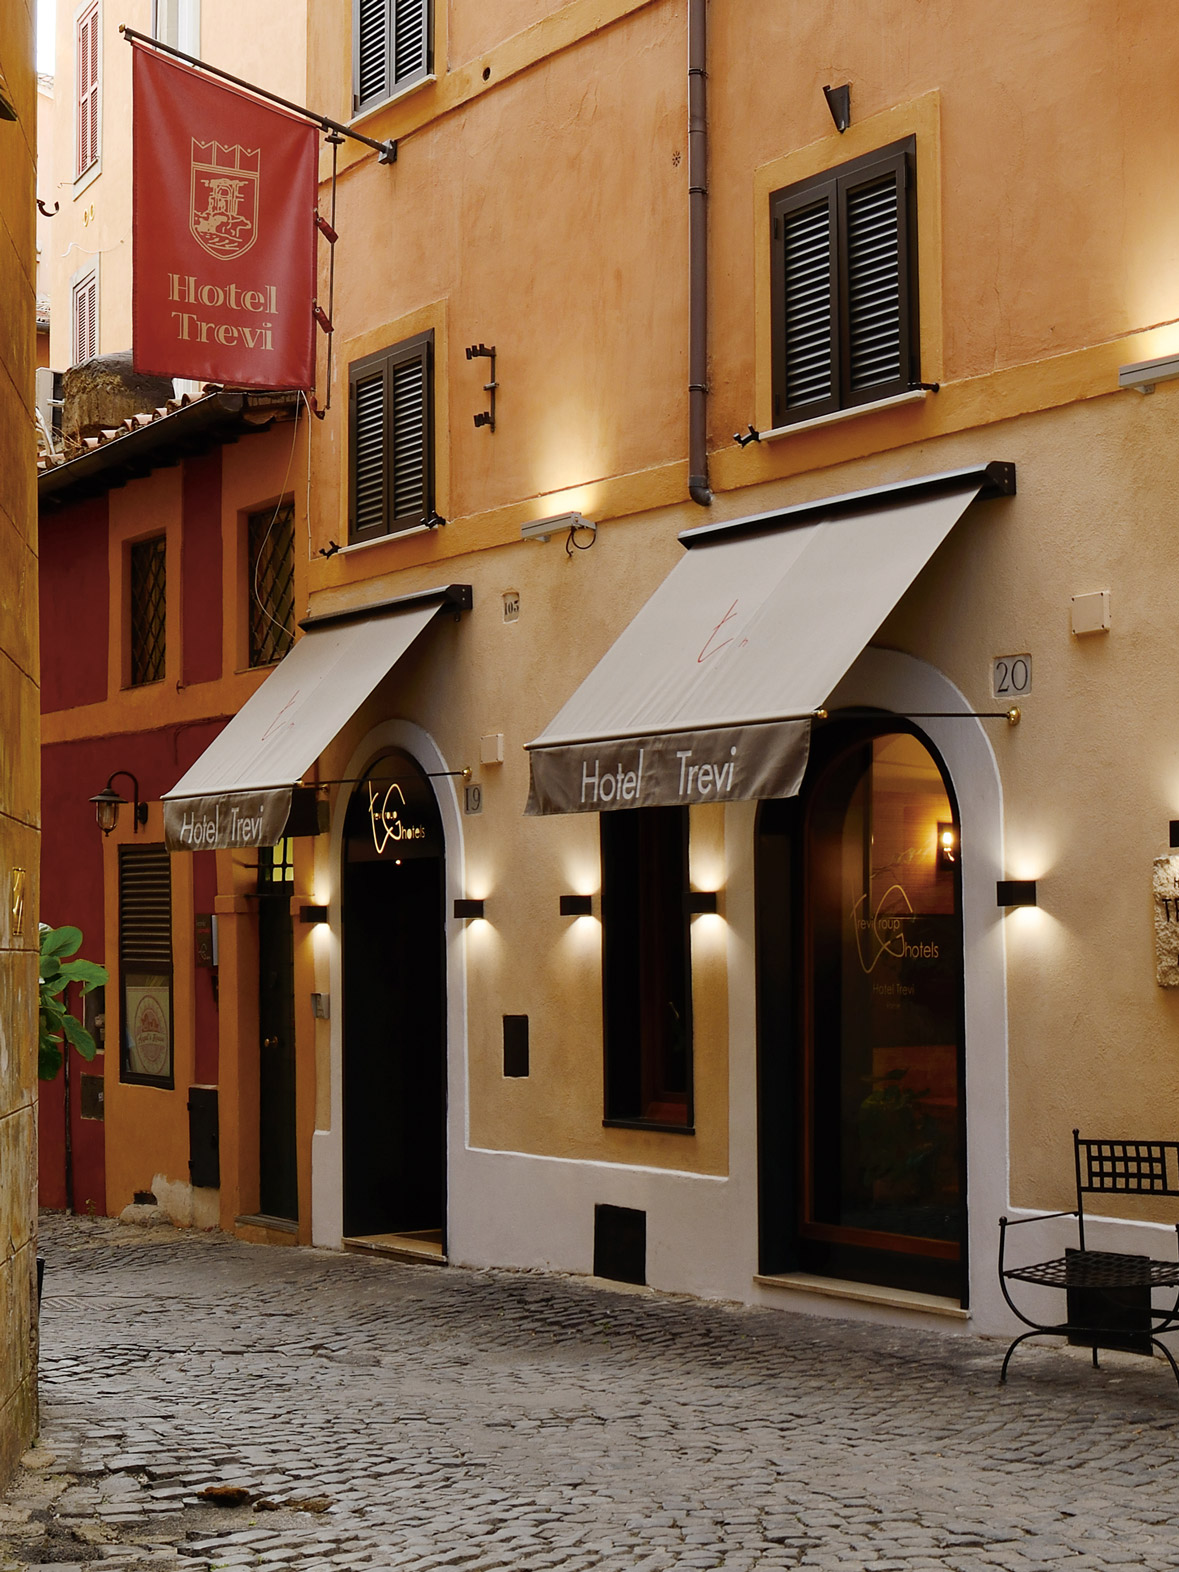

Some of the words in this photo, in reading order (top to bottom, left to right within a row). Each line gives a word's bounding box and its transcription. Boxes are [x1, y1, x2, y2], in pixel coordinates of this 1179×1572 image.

[168, 273, 279, 314] Hotel
[171, 312, 274, 350] Trevi
[996, 659, 1028, 693] 20
[581, 748, 644, 803] Hotel
[676, 746, 737, 796] Trevi
[465, 787, 481, 812] 19
[180, 804, 219, 844] Hotel
[231, 805, 264, 841] Trevi
[904, 942, 939, 959] hotels
